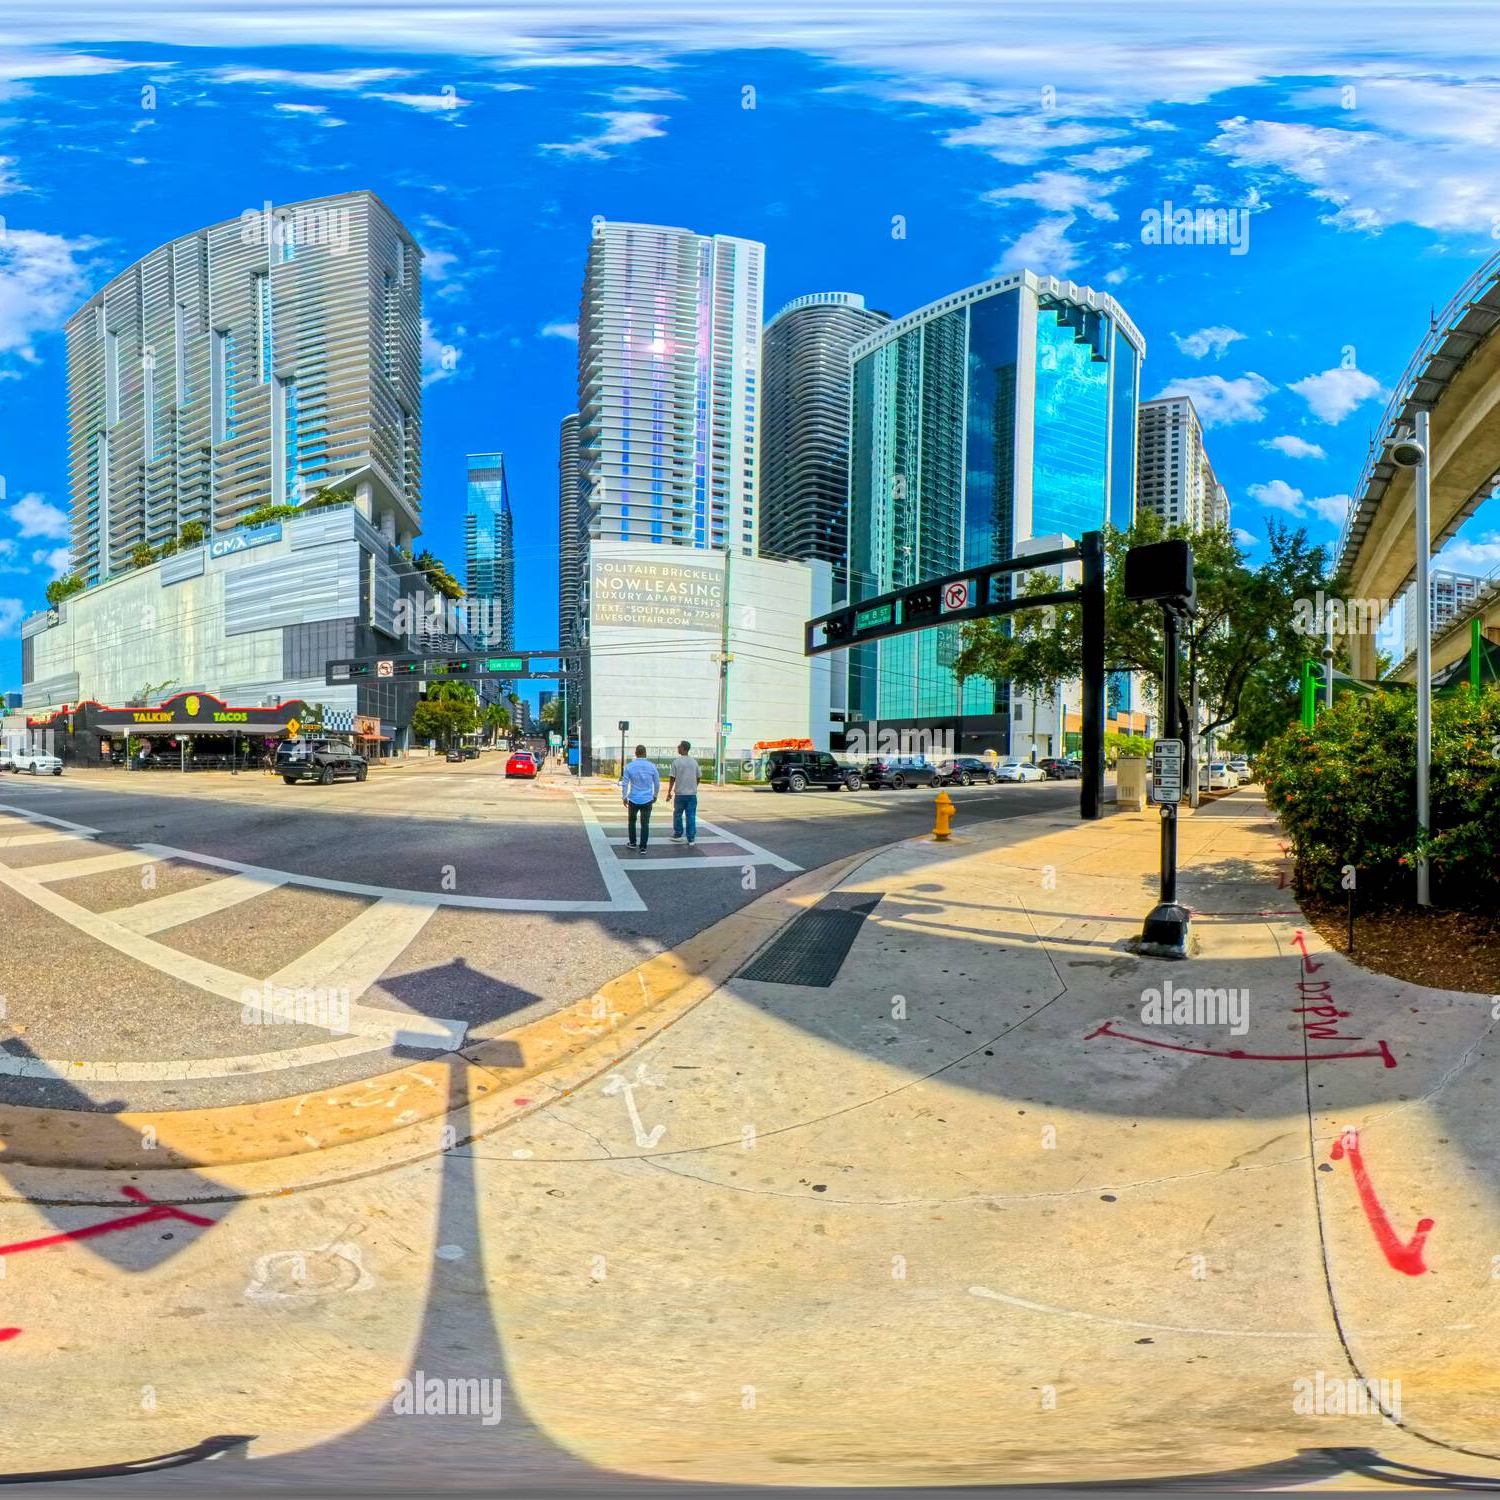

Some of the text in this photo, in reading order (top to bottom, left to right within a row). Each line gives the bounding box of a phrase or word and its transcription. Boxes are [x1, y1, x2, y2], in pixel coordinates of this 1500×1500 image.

[212, 536, 247, 555] CMX
[596, 562, 721, 582] SOLITAIR BRICKELL
[595, 577, 721, 598] NOW LEASING
[595, 591, 722, 608] LUXURY APARTMENTS
[596, 604, 623, 612] TEXT:
[595, 613, 690, 625] LIVESOLITAIR.COM
[213, 712, 248, 722] TACOS
